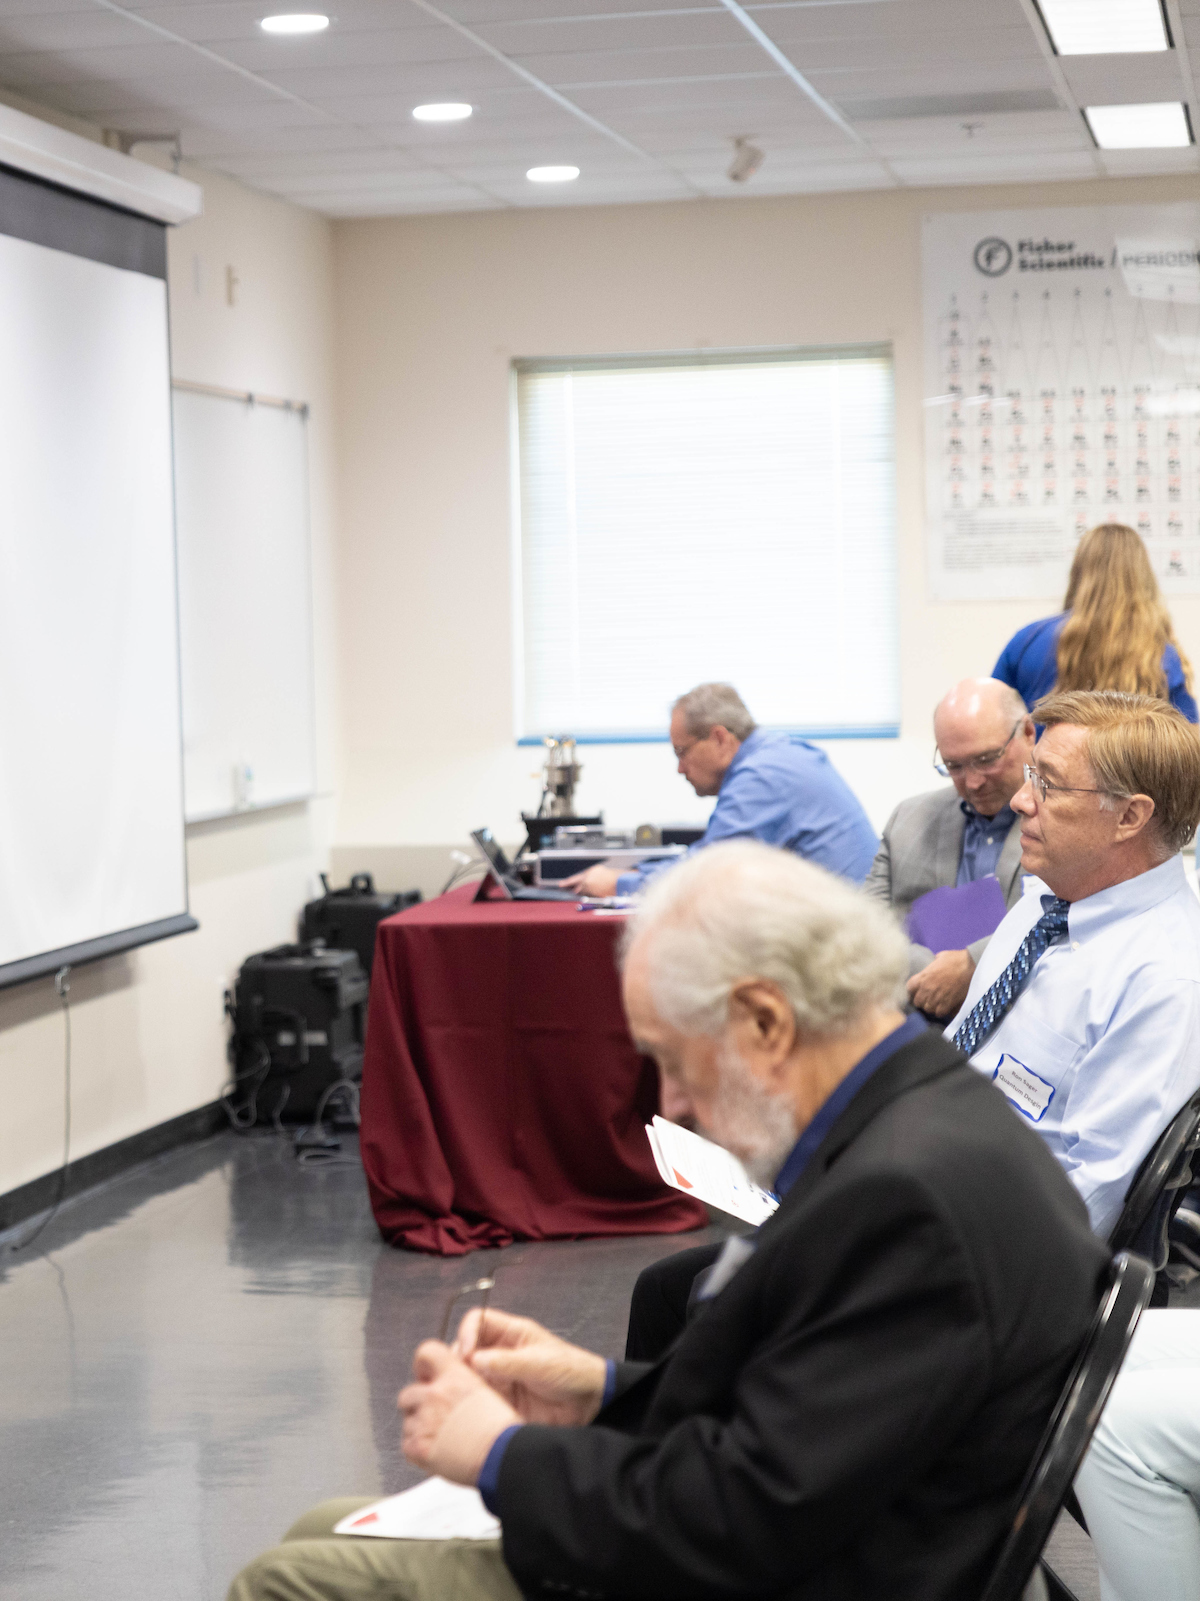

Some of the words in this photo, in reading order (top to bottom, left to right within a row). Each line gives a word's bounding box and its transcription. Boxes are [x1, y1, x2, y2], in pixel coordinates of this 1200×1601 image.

[1019, 254, 1104, 271] Scientific
[999, 1074, 1024, 1095] Quantum
[1011, 1071, 1022, 1081] Ron
[1023, 1079, 1038, 1093] Sager
